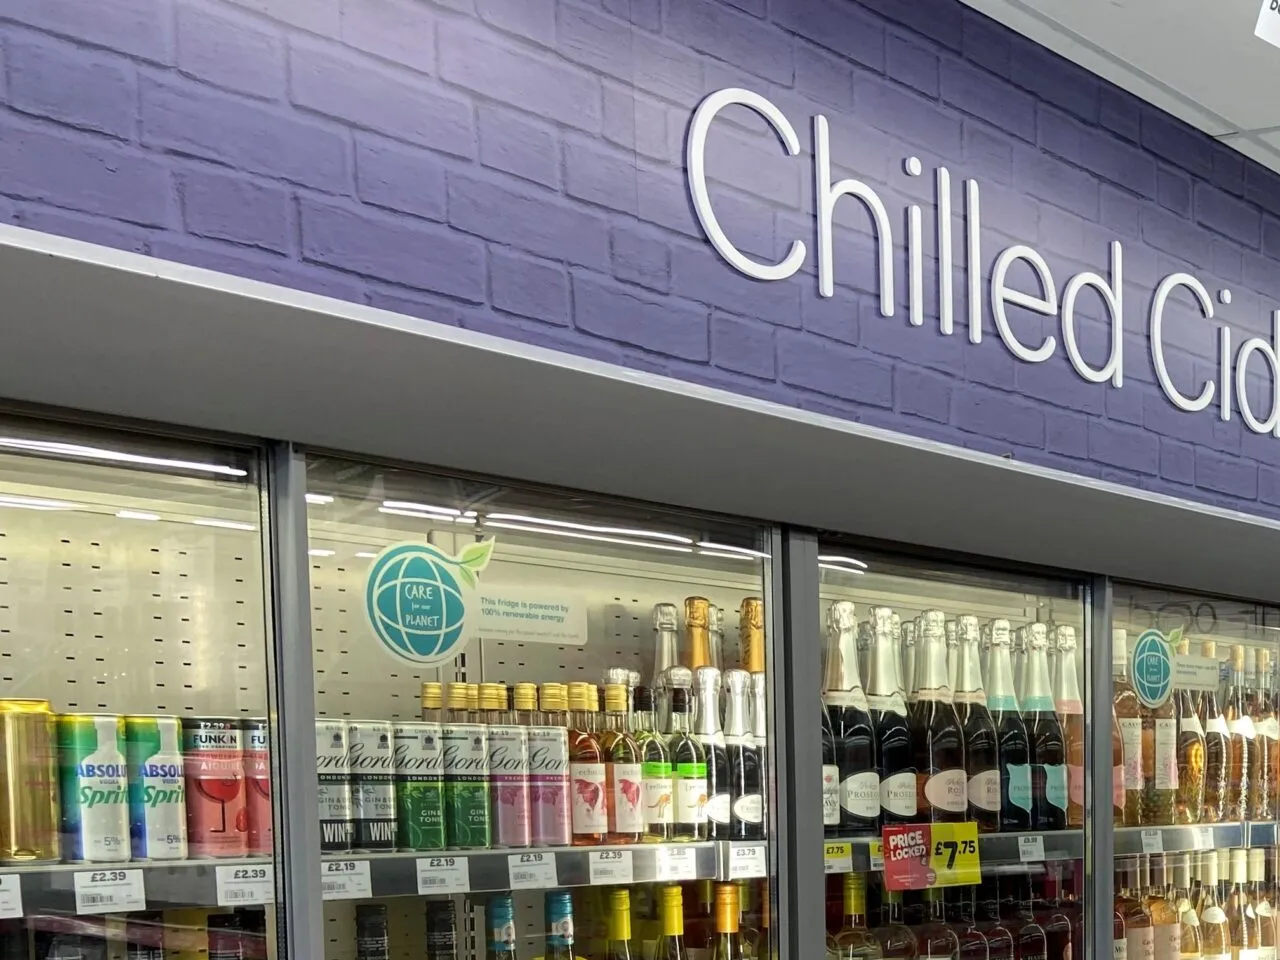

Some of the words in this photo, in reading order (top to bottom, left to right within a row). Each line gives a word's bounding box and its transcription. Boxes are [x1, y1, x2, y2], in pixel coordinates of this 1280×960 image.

[686, 86, 1124, 388] Chilled
[405, 585, 432, 600] CARE
[480, 597, 496, 606] This
[497, 599, 519, 610] fridge
[529, 603, 562, 613] powered
[481, 608, 501, 617] 100%
[502, 610, 539, 620] renewable
[405, 614, 440, 627] PLANET
[889, 830, 923, 850] PRICE
[600, 850, 622, 860] £2.39
[736, 848, 756, 857] £3.79
[826, 846, 845, 854] £7.75
[934, 840, 976, 870] £7.75
[430, 858, 455, 867] £2.19
[520, 853, 543, 862] £2.19
[328, 862, 355, 872] £2.19
[90, 871, 126, 882] £2.39
[234, 868, 266, 880] £2.39
